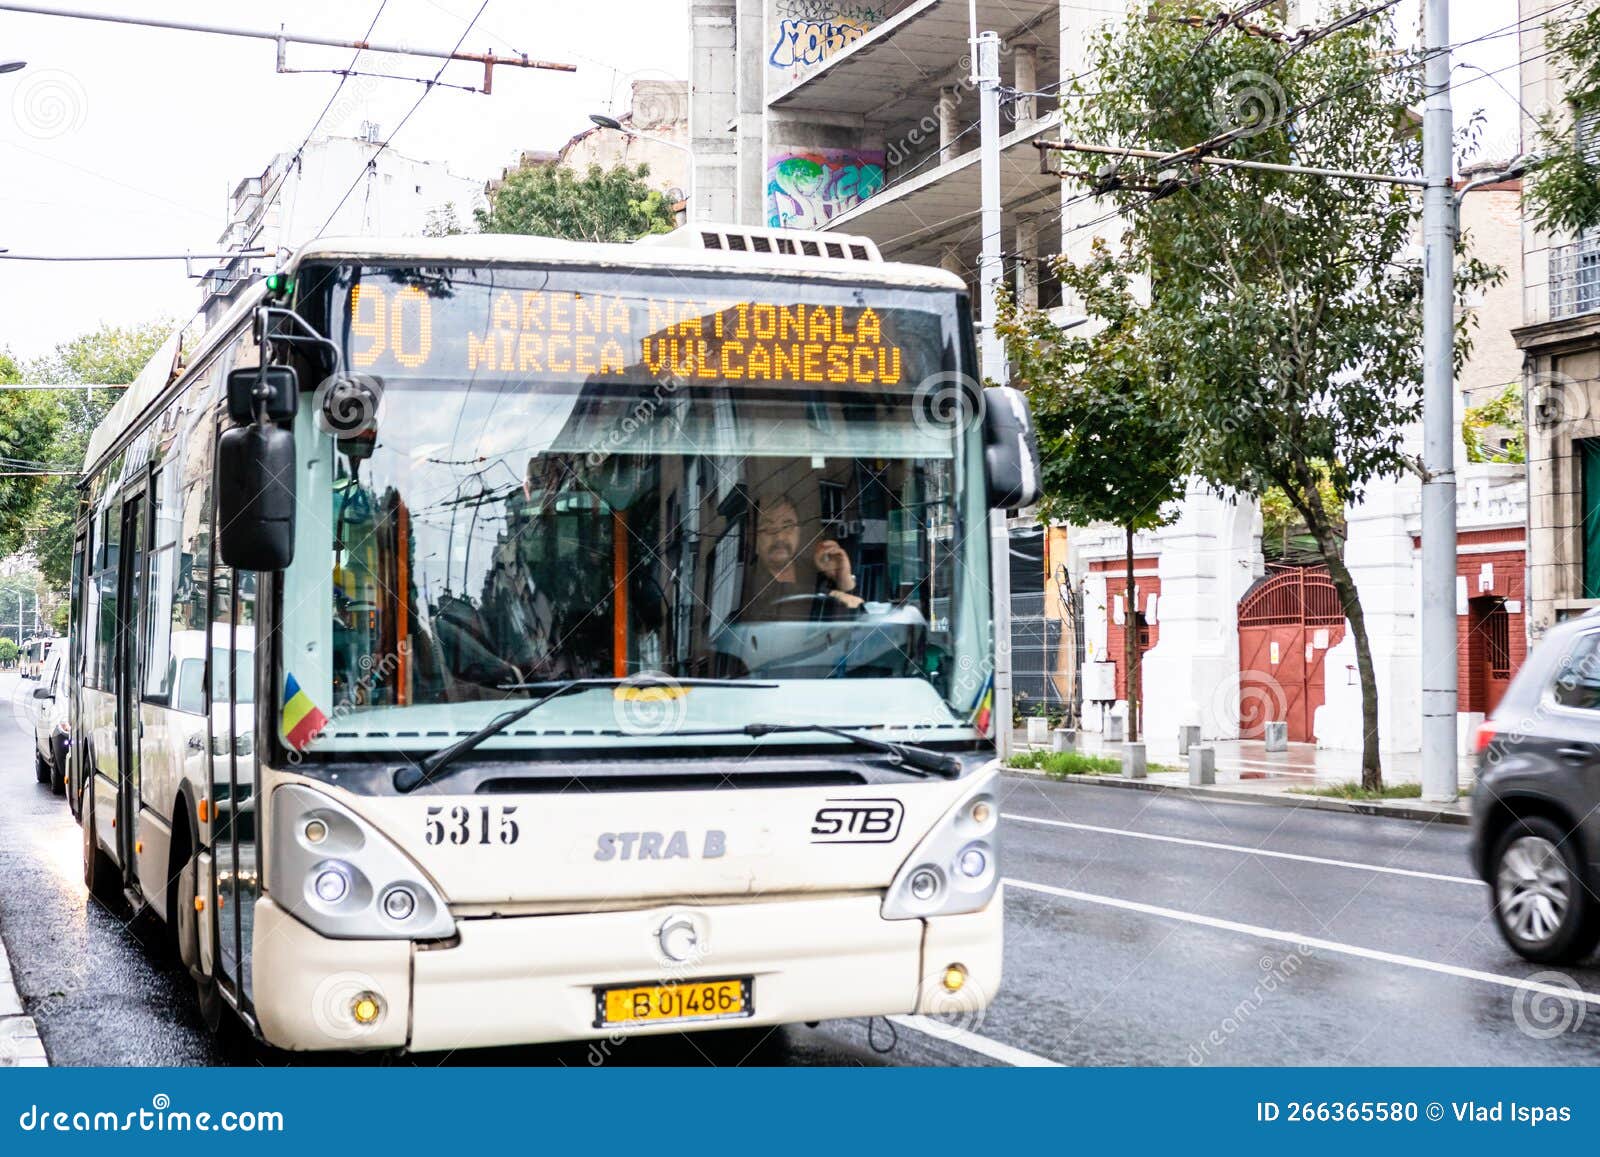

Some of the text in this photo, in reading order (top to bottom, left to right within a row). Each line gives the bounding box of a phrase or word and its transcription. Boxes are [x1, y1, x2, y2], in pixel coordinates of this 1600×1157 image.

[351, 284, 431, 368] 90
[492, 290, 881, 344] ARENA NATIONALA
[468, 331, 900, 385] MIRCEA VULCANESCU
[425, 805, 520, 845] 5315
[811, 807, 895, 835] STB
[594, 830, 728, 861] STRA B
[633, 985, 734, 1018] B 01486
